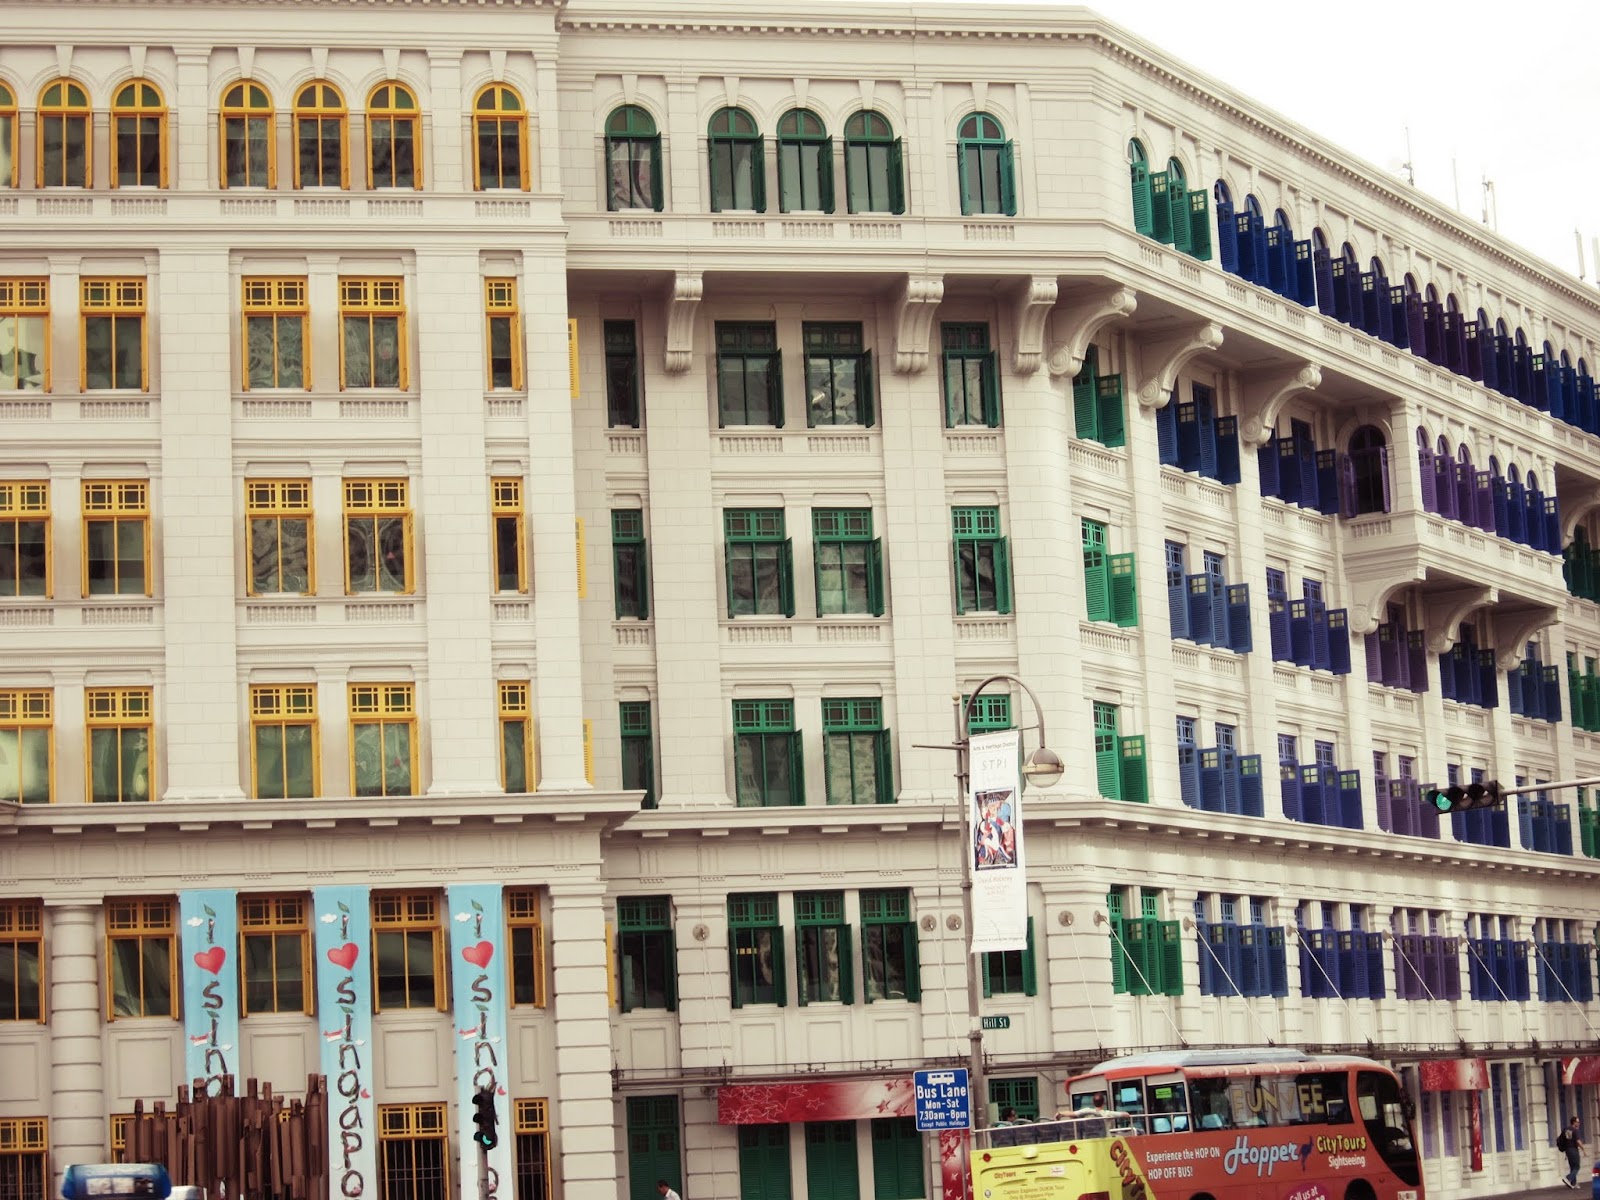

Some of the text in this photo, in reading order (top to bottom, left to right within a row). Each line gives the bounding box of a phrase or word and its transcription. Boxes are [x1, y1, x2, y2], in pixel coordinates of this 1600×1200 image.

[982, 758, 1007, 771] STPI
[983, 1017, 1007, 1029] Hill St
[917, 1084, 967, 1099] Bus Lane
[1146, 1146, 1220, 1164] Experience the HOP ON
[1223, 1135, 1299, 1177] Hopper
[1328, 1156, 1366, 1168] Sightseeing
[1148, 1165, 1193, 1180] HOP OFF BUS!
[1311, 1185, 1318, 1197] at
